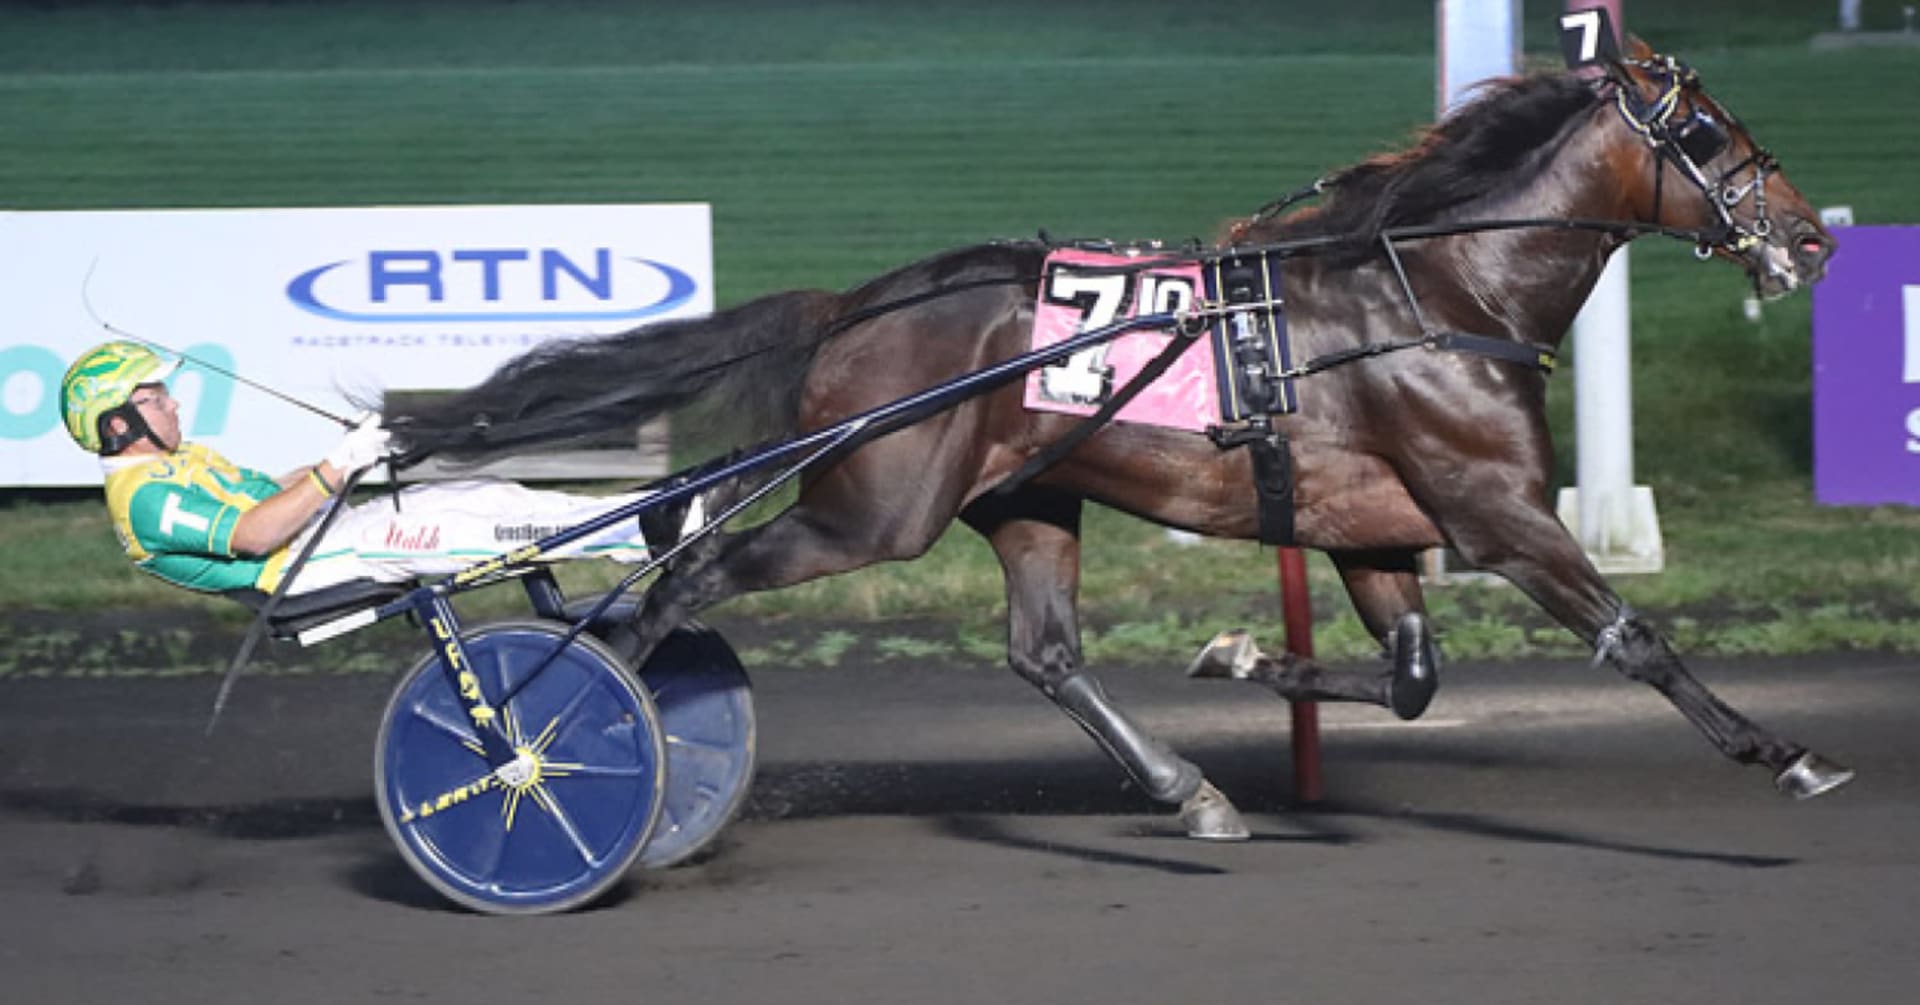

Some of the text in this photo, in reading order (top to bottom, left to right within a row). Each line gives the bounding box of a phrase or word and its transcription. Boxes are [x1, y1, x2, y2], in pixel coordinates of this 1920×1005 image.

[1561, 10, 1599, 61] 7
[367, 247, 612, 303] RTN
[291, 335, 425, 347] RACETRACK
[1047, 267, 1127, 400] 7
[159, 491, 210, 537] T
